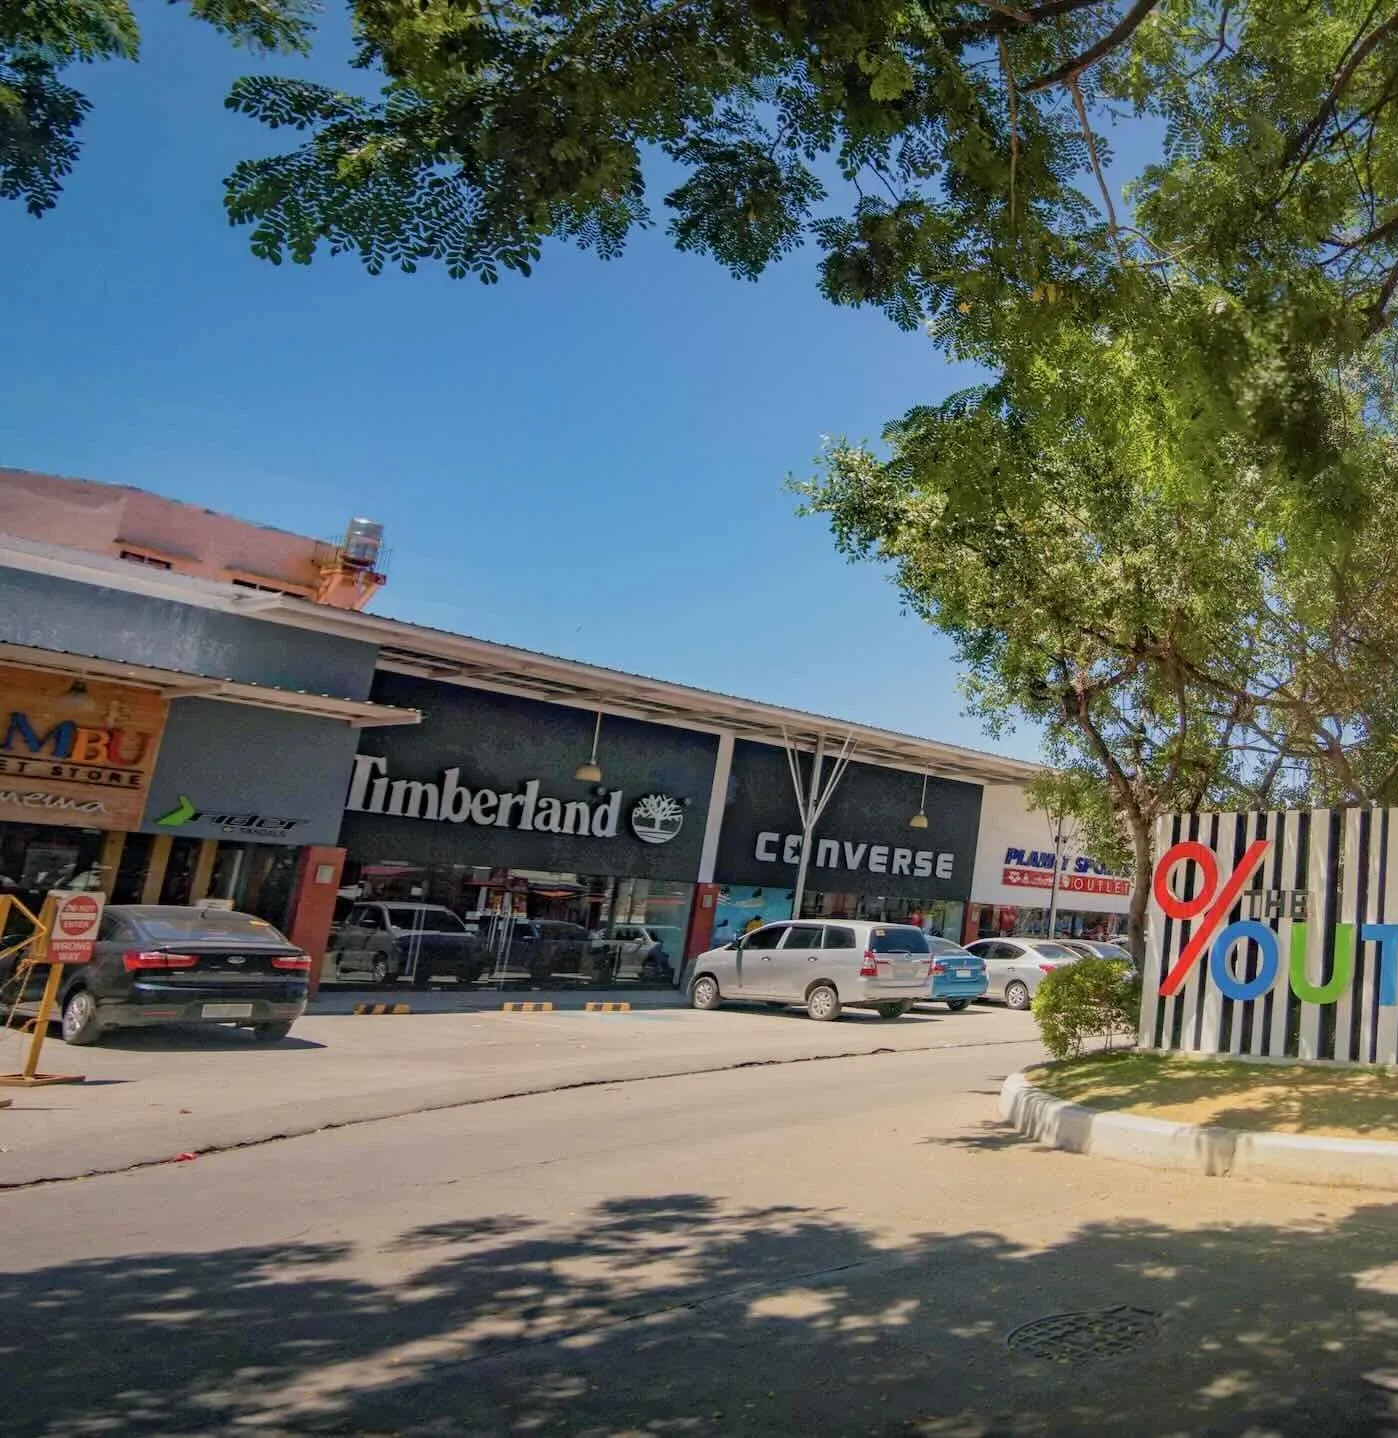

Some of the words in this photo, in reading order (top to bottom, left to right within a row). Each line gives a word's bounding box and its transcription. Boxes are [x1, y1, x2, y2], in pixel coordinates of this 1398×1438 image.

[0, 711, 151, 767] MBU
[51, 766, 141, 786] STORE
[346, 753, 624, 838] Timberland
[754, 831, 955, 880] CONVERSE
[1004, 847, 1070, 871] PLANT
[1072, 877, 1130, 897] OUTLET
[1243, 889, 1310, 919] THE
